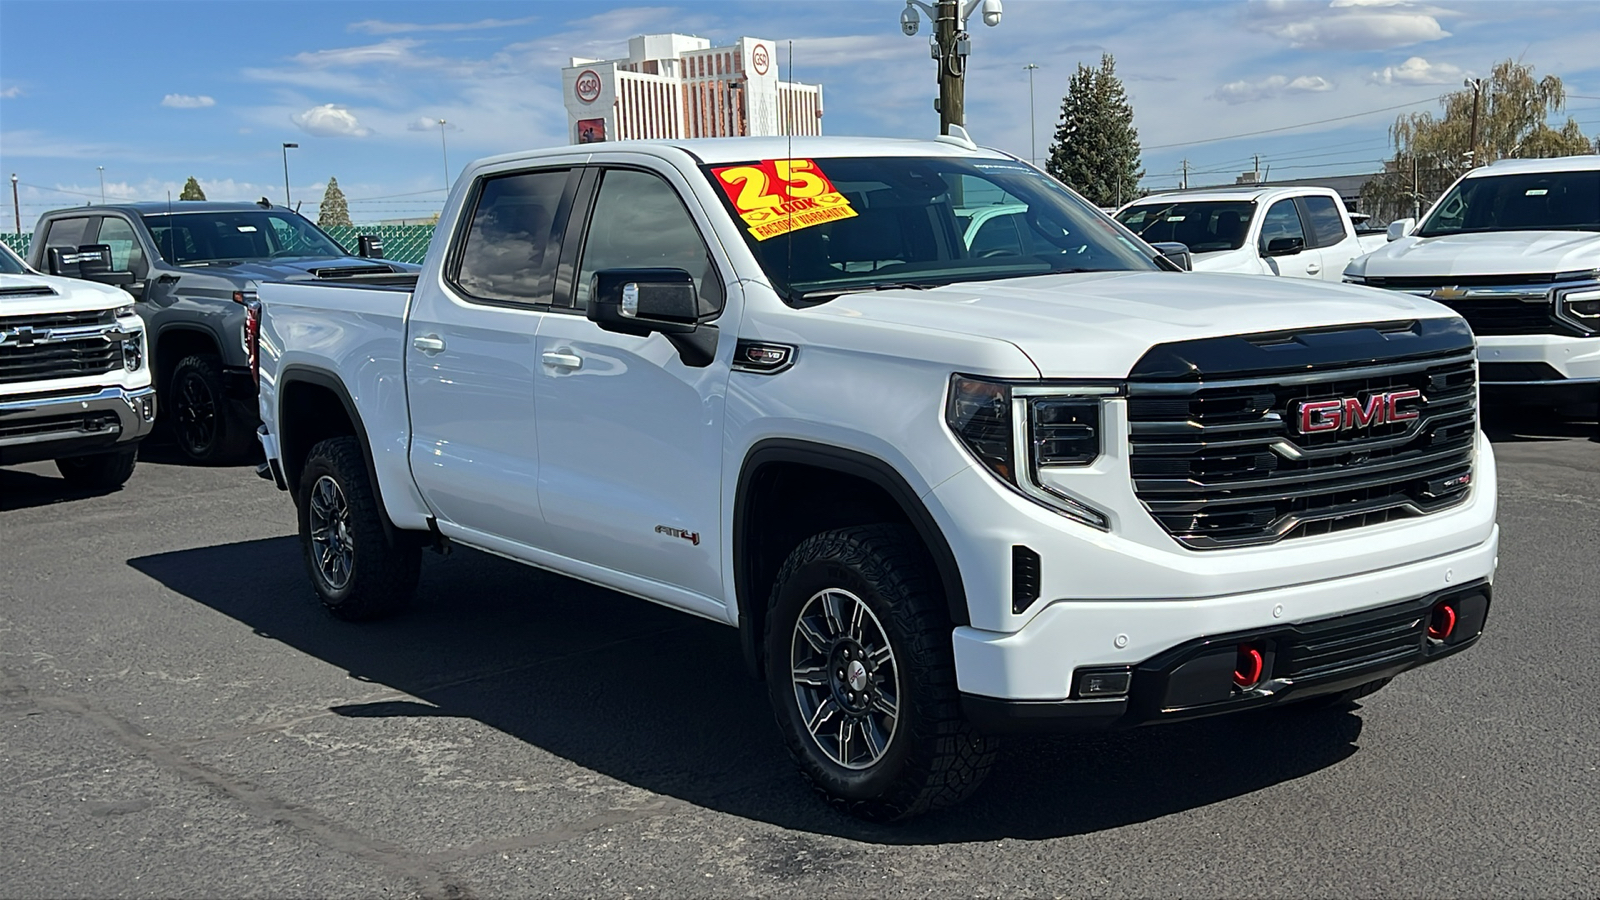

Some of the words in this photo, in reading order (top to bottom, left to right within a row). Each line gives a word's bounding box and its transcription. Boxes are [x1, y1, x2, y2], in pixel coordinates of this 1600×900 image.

[579, 79, 598, 94] GSR
[719, 159, 829, 211] 25
[770, 197, 821, 217] LOOK
[755, 218, 799, 238] FACTORY
[798, 206, 850, 225] WARRANTY
[1298, 389, 1420, 434] GMC
[654, 524, 700, 547] AT4
